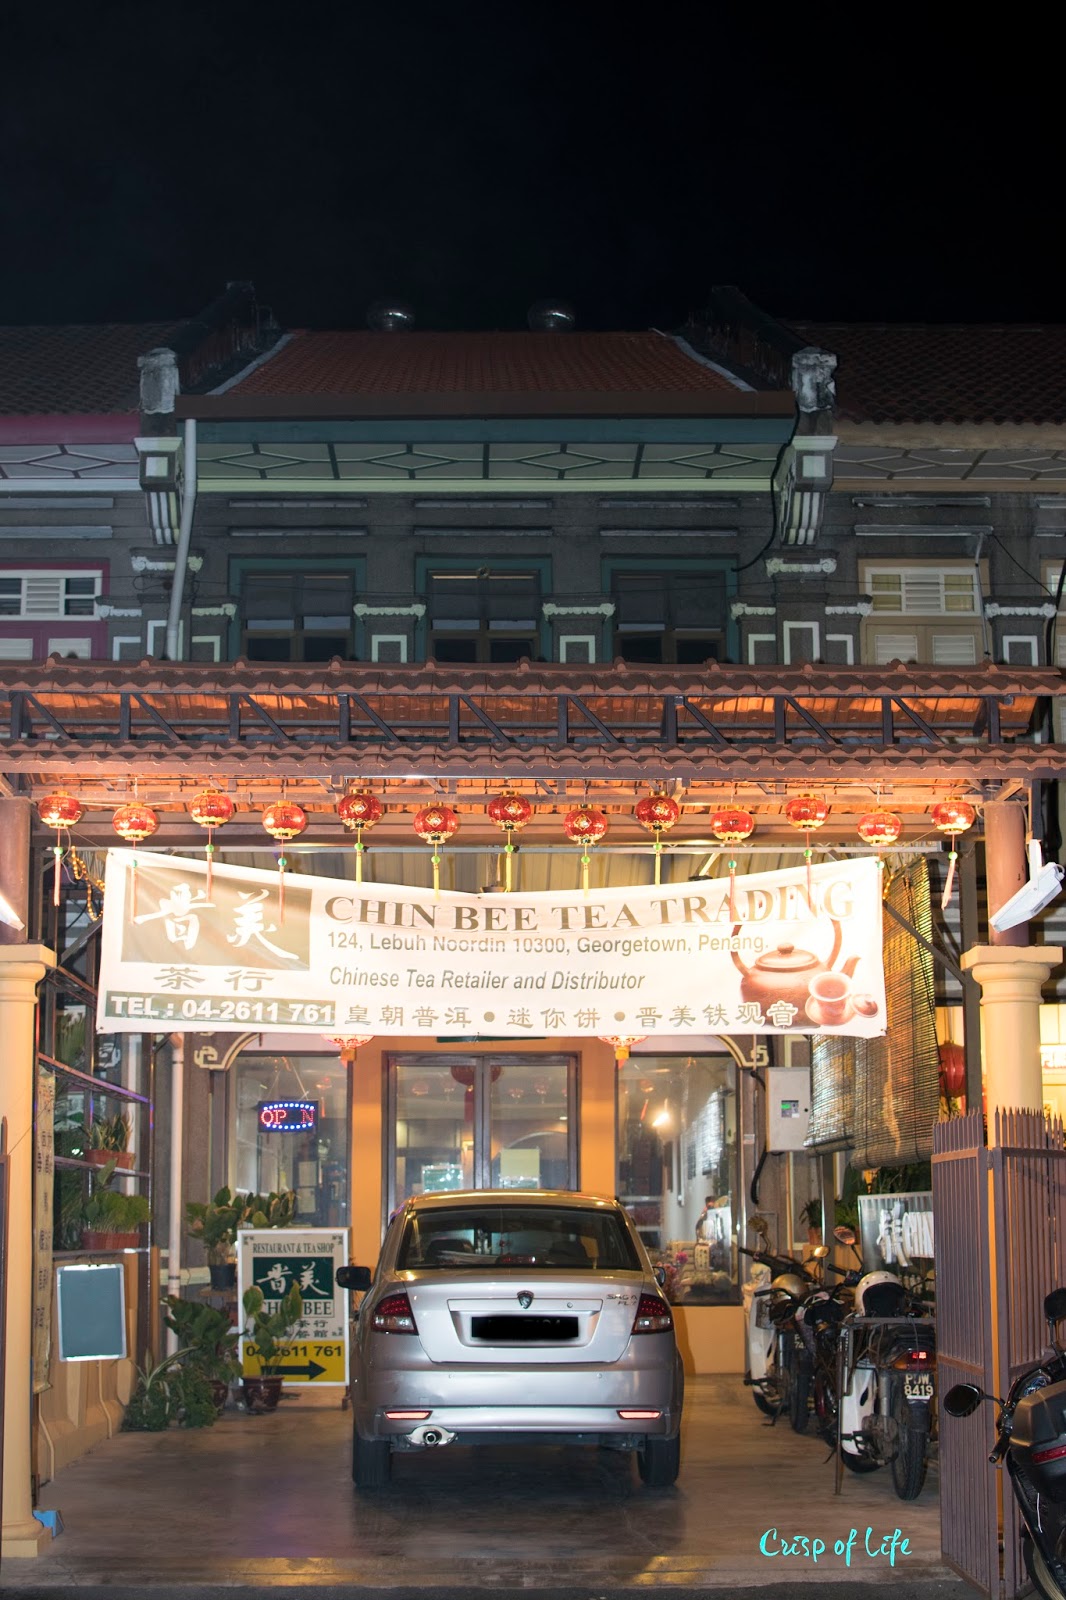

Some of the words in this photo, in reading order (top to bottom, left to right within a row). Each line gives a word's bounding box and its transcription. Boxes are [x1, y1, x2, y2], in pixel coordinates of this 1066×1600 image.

[325, 896, 437, 928] CHIN
[452, 906, 538, 931] BEE
[551, 904, 641, 930] TEA
[651, 881, 853, 924] TRADING
[328, 932, 363, 952] 124,
[370, 933, 426, 950] Lebuh
[433, 936, 505, 952] Noordin
[513, 938, 570, 955] 10300,
[577, 937, 691, 956] Georgetown,
[699, 934, 769, 953] Penang.
[154, 967, 274, 991] 茶行
[329, 966, 399, 988] Chinese
[407, 969, 436, 988] Tea
[441, 969, 509, 989] Retailer
[513, 971, 546, 989] and
[551, 970, 645, 989] Distributor
[182, 999, 278, 1022] 04-2611
[288, 1003, 333, 1023] 761
[344, 1004, 472, 1029] 皇朝普洱
[505, 1007, 601, 1029] 迷你饼
[635, 1001, 798, 1029] 晋美铁观音
[260, 1109, 315, 1125] OPN
[252, 1243, 295, 1254] RESTAURANT
[303, 1243, 317, 1254] TEA
[317, 1243, 335, 1254] SHOP
[304, 1302, 332, 1315] BEE
[314, 1346, 342, 1357] 761
[904, 1385, 934, 1396] 8419
